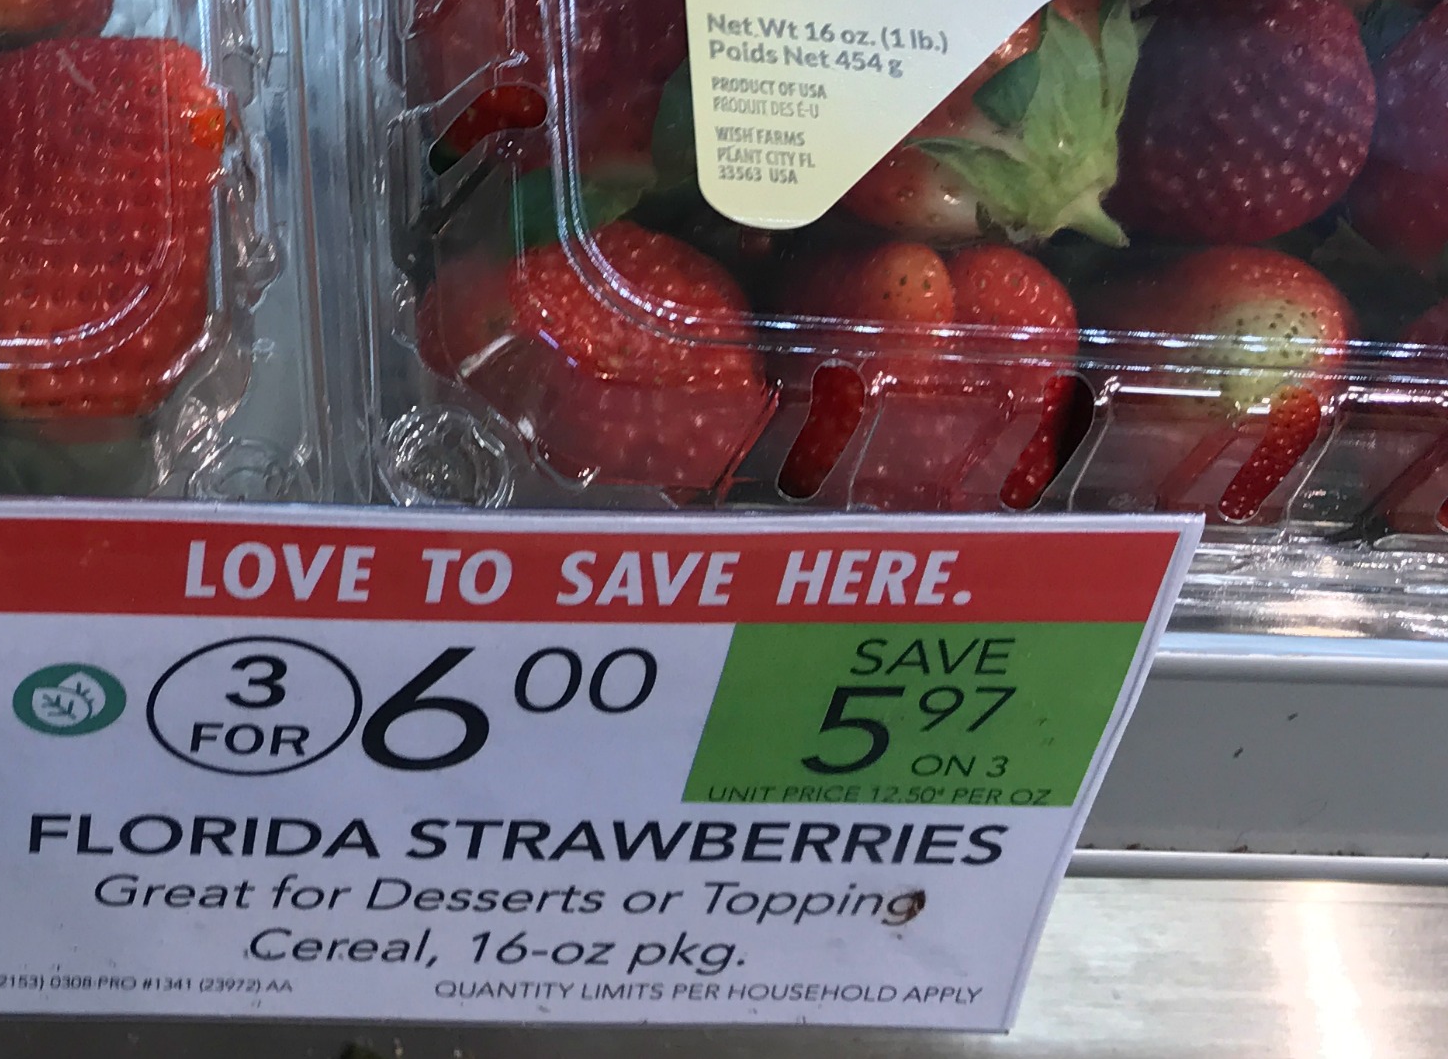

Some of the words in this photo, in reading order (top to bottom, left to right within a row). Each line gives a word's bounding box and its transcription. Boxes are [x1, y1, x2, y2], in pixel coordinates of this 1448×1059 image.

[706, 13, 753, 37] Net
[757, 16, 798, 42] Wt
[805, 21, 836, 43] 16
[840, 28, 876, 47] oz.
[881, 25, 905, 50] (1
[909, 29, 949, 54] lb.)
[708, 39, 778, 65] Poids
[783, 46, 830, 69] Net
[835, 50, 883, 73] 454
[888, 57, 903, 78] g
[711, 76, 774, 95] PRODUCT
[778, 81, 796, 97] OF
[799, 83, 827, 99] USA
[713, 95, 767, 115] PRODUIT
[771, 100, 794, 117] DES
[714, 126, 754, 143] WISH
[756, 129, 806, 146] FARMS
[717, 146, 763, 164] PLANT
[765, 150, 796, 167] CITY
[798, 153, 816, 168] FL
[718, 165, 762, 182] 33563
[769, 167, 798, 184] USA
[184, 542, 375, 604] LOVE
[423, 547, 513, 606] TO
[556, 549, 737, 608] SAVE
[776, 548, 975, 608] HERE.
[849, 637, 1016, 676] SAVE
[226, 655, 287, 709] 3
[360, 647, 490, 771] 6
[513, 647, 658, 714] 00
[189, 722, 311, 757] FOR
[800, 685, 906, 776] 5
[918, 685, 1017, 733] 97
[911, 755, 977, 778] ON
[985, 755, 1009, 778] 3
[708, 786, 777, 803] UNIT
[782, 786, 862, 804] PRICE
[952, 787, 1002, 805] PER
[1009, 789, 1051, 806] OZ
[29, 813, 378, 861] FLORIDA
[404, 817, 1009, 868] STRAWBERRIES
[94, 874, 251, 910] Great
[271, 876, 350, 912] for
[365, 877, 605, 914] Desserts
[624, 888, 682, 915] or
[703, 881, 924, 926] Topping
[249, 929, 441, 968] Cereal,
[470, 931, 610, 966] 16-oz
[627, 932, 747, 974] pkg.
[97, 976, 138, 991] PRO
[142, 976, 192, 992] #1341
[265, 978, 293, 994] AA
[435, 981, 573, 1000] QUANTITY
[580, 981, 663, 1001] LIMITS
[672, 983, 721, 1002] PER
[728, 984, 898, 1004] HOUSEHOLD
[903, 985, 982, 1005] APPLY
